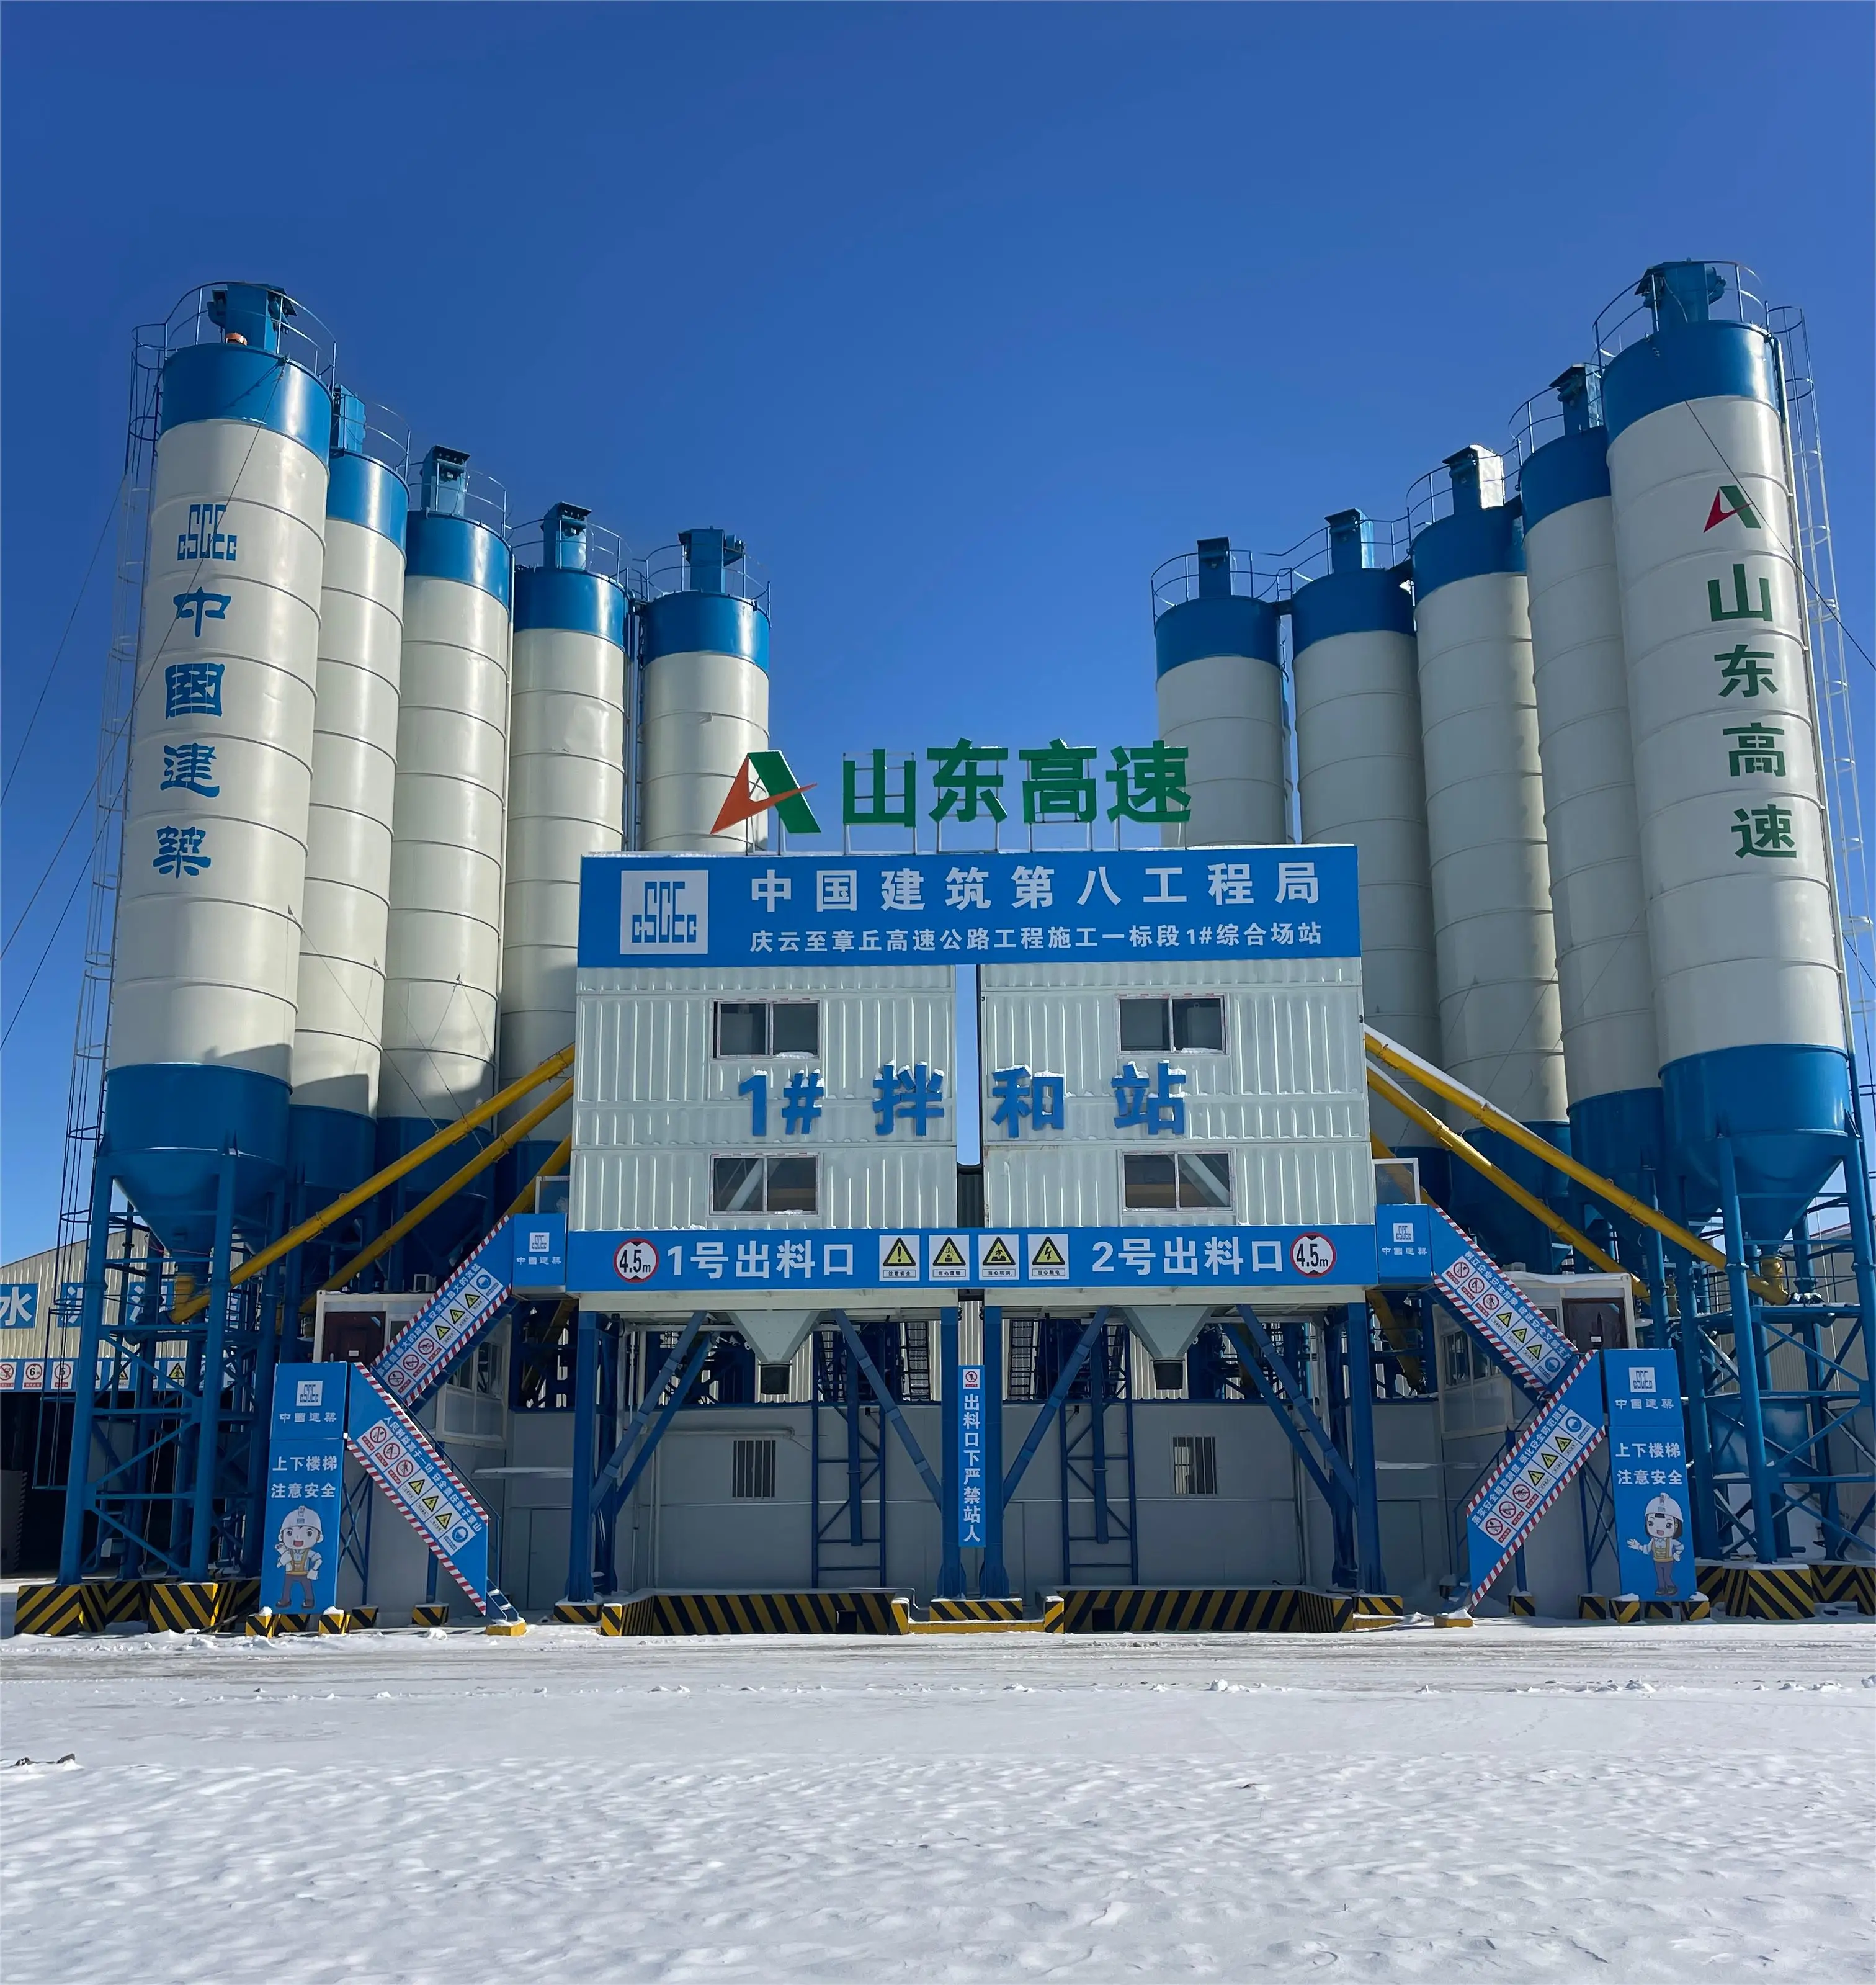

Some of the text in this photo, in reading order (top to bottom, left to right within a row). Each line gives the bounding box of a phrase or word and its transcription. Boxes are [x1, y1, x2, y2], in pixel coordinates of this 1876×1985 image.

[1707, 564, 1797, 858] 山东高速
[843, 738, 1192, 824] 山东高速
[751, 862, 1320, 912] 中国建筑第八工程局
[750, 922, 1322, 953] 庆云至章丘高速公路工程施工一标段1#综合场站
[619, 1249, 651, 1273] 4.5m
[668, 1240, 853, 1279] 1号出料口
[1092, 1237, 1282, 1275] 2号出料口
[1296, 1243, 1329, 1267] 4.5m
[383, 1415, 435, 1473] 人民利益高于一切
[1615, 1443, 1681, 1458] 上下楼梯
[272, 1456, 337, 1471] 上下楼梯
[963, 1394, 981, 1543] 出料口下严禁站人
[1617, 1469, 1682, 1485] 注意安全
[270, 1482, 336, 1498] 注意安全
